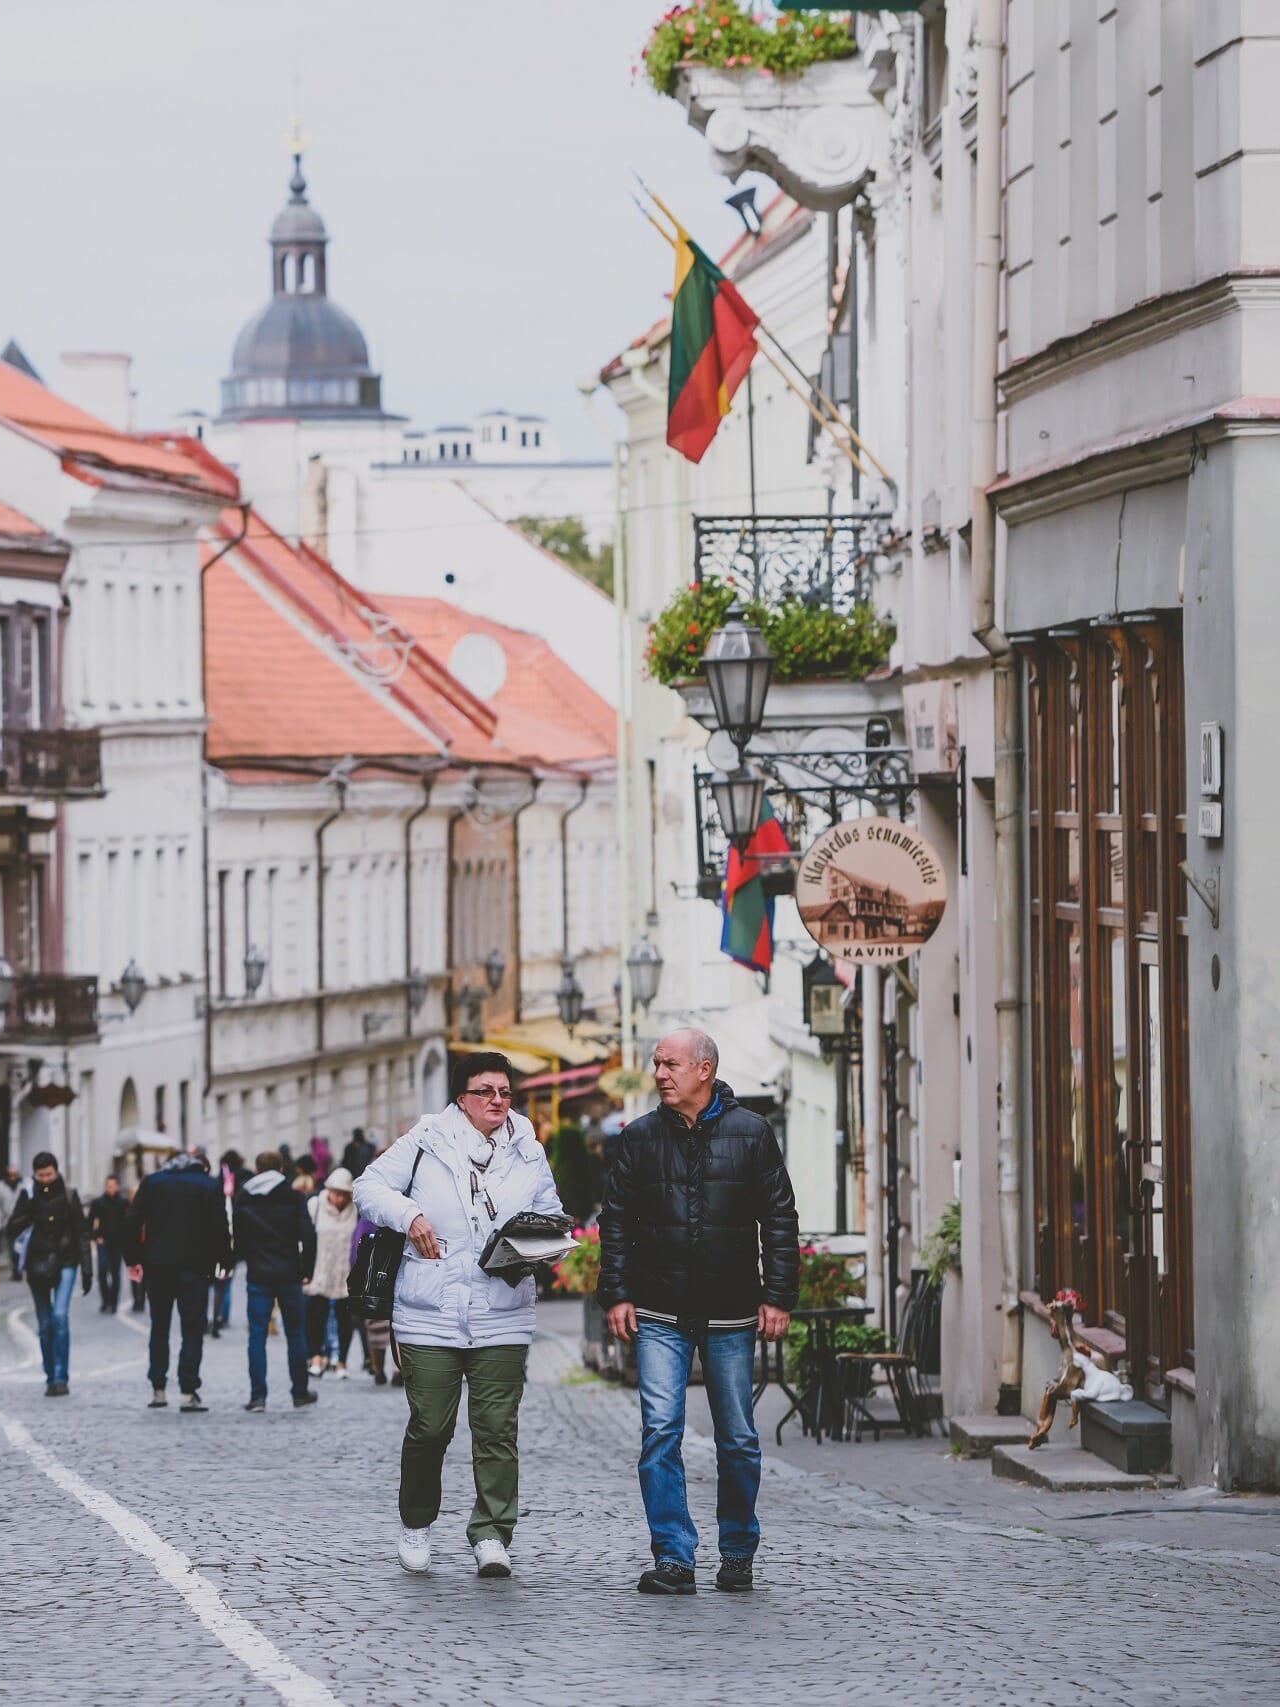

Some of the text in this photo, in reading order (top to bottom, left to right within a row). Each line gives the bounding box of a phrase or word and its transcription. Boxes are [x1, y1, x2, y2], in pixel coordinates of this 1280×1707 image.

[1202, 732, 1213, 785] 30
[866, 825, 940, 886] senamiestis
[843, 946, 905, 958] KAVINĖ
